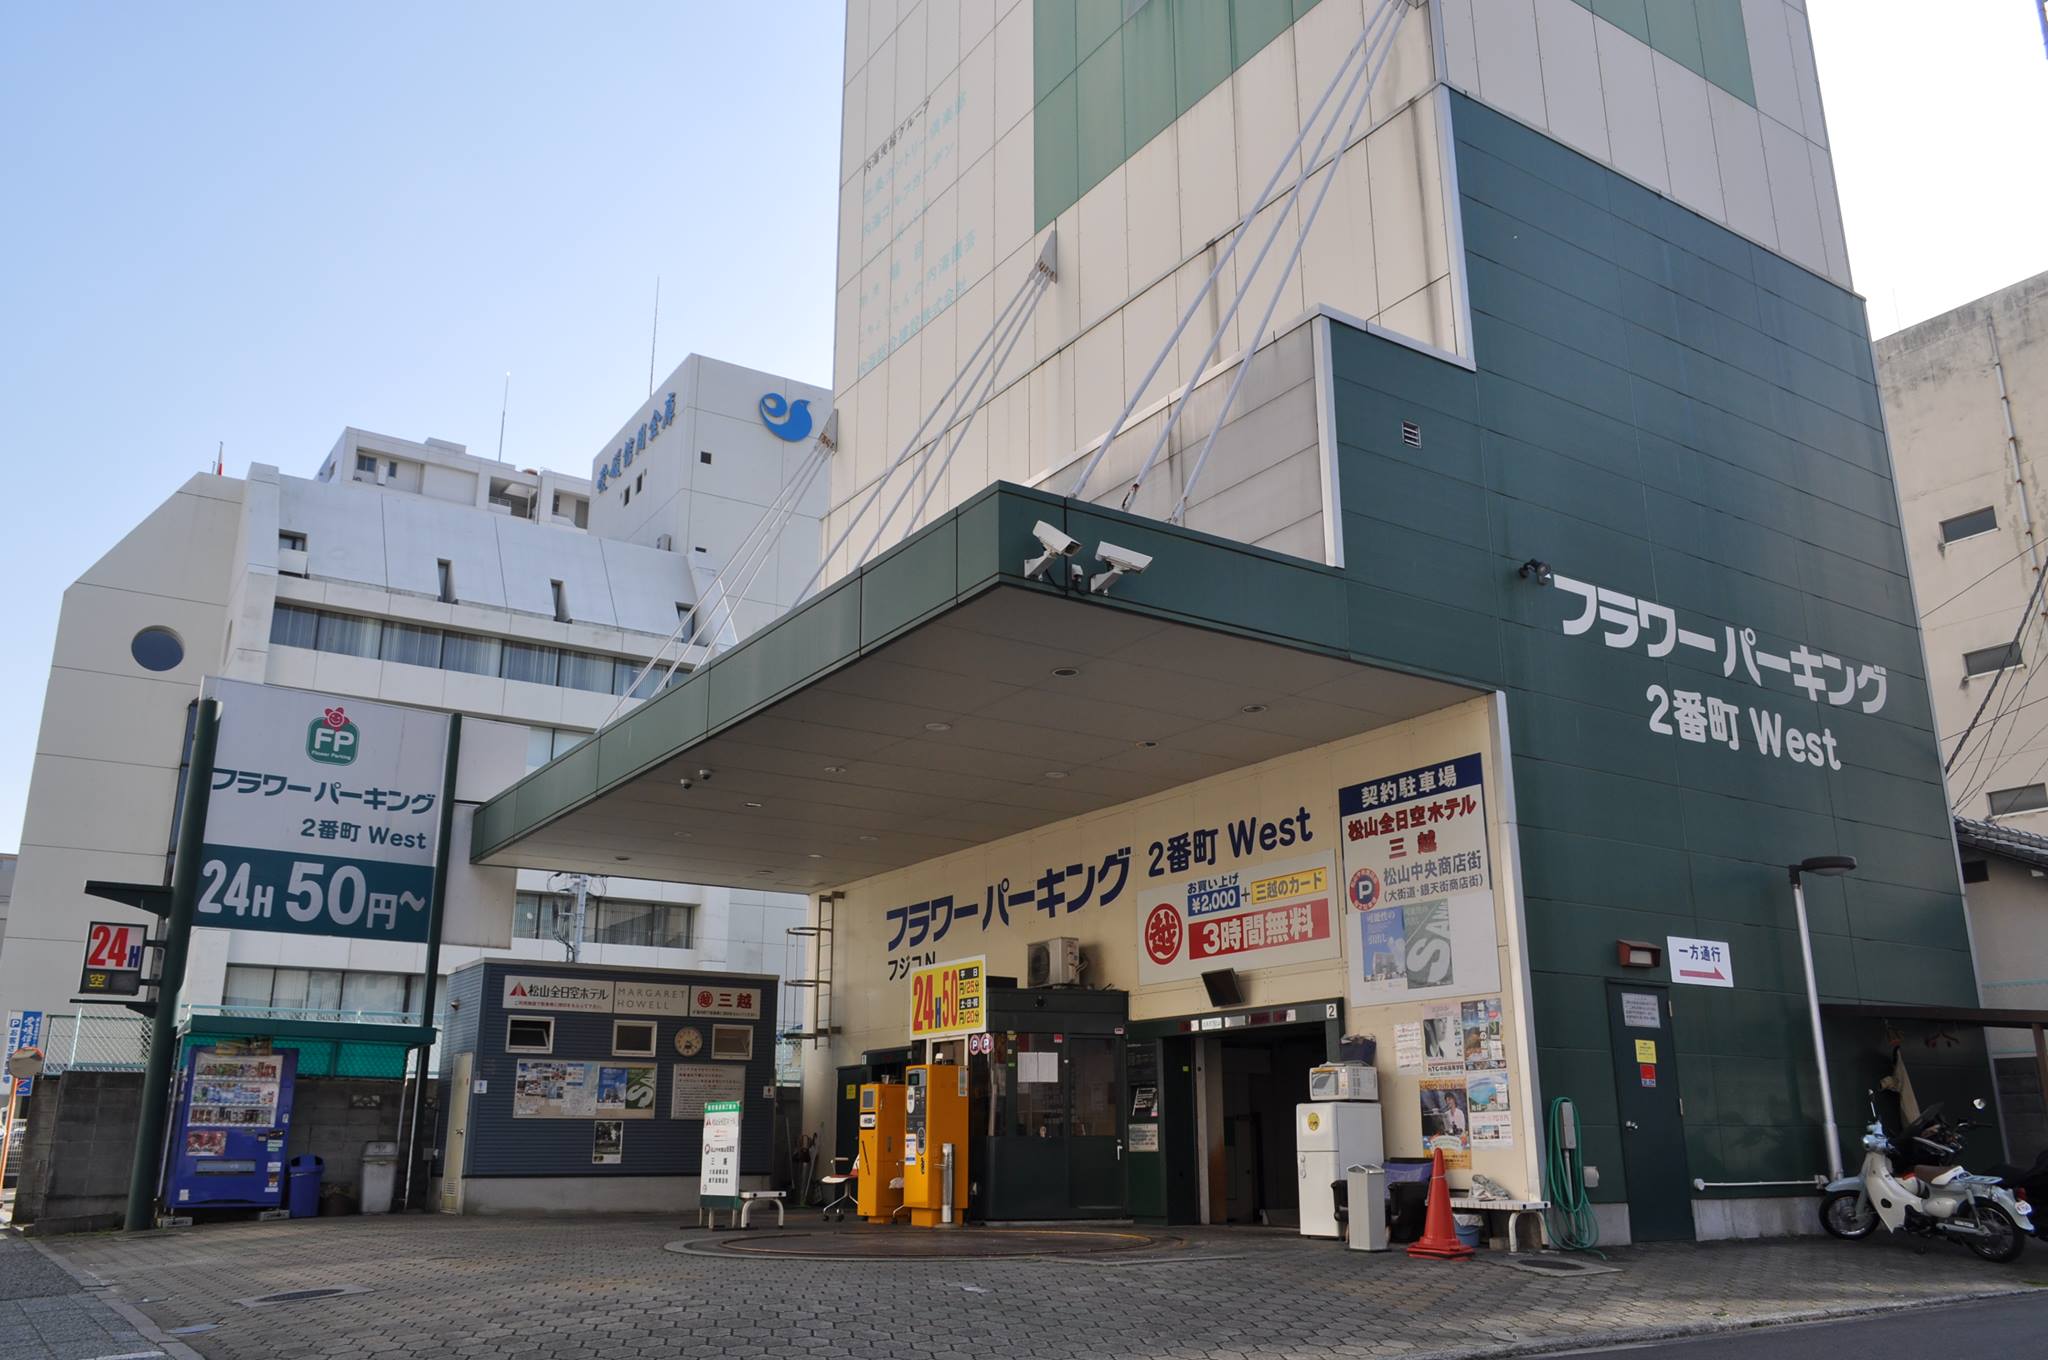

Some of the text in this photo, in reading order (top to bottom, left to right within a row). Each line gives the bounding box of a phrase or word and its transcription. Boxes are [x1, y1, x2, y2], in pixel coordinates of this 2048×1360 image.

[1553, 573, 1887, 714] フラワーパーキング
[314, 728, 355, 752] FP
[1646, 684, 1841, 771] 2番町 West
[211, 767, 436, 815] フラワーパーキング
[1361, 764, 1457, 808] 契約駐車場
[300, 818, 427, 850] 2番町 West
[1347, 794, 1477, 842] 松山全日空ホテル
[1148, 806, 1314, 879] 2番町 West
[1187, 871, 1239, 895] お買い上げ
[1383, 849, 1482, 887] 松山中央商店街
[198, 859, 274, 918] 24H
[886, 846, 1132, 952] フラワーパーキング
[1191, 889, 1236, 914] ¥2,000
[1255, 869, 1322, 902] 三越のカード
[88, 925, 141, 968] 24H
[1202, 904, 1314, 955] 3時間無料
[1678, 944, 1721, 963] 一方通行
[88, 973, 105, 988] 空
[527, 983, 609, 1000] 松山全日空ホテル
[618, 988, 686, 999] MARGARET
[617, 1000, 669, 1010] HOWELL
[718, 993, 752, 1009] 三越
[1327, 1005, 1335, 1018] 2
